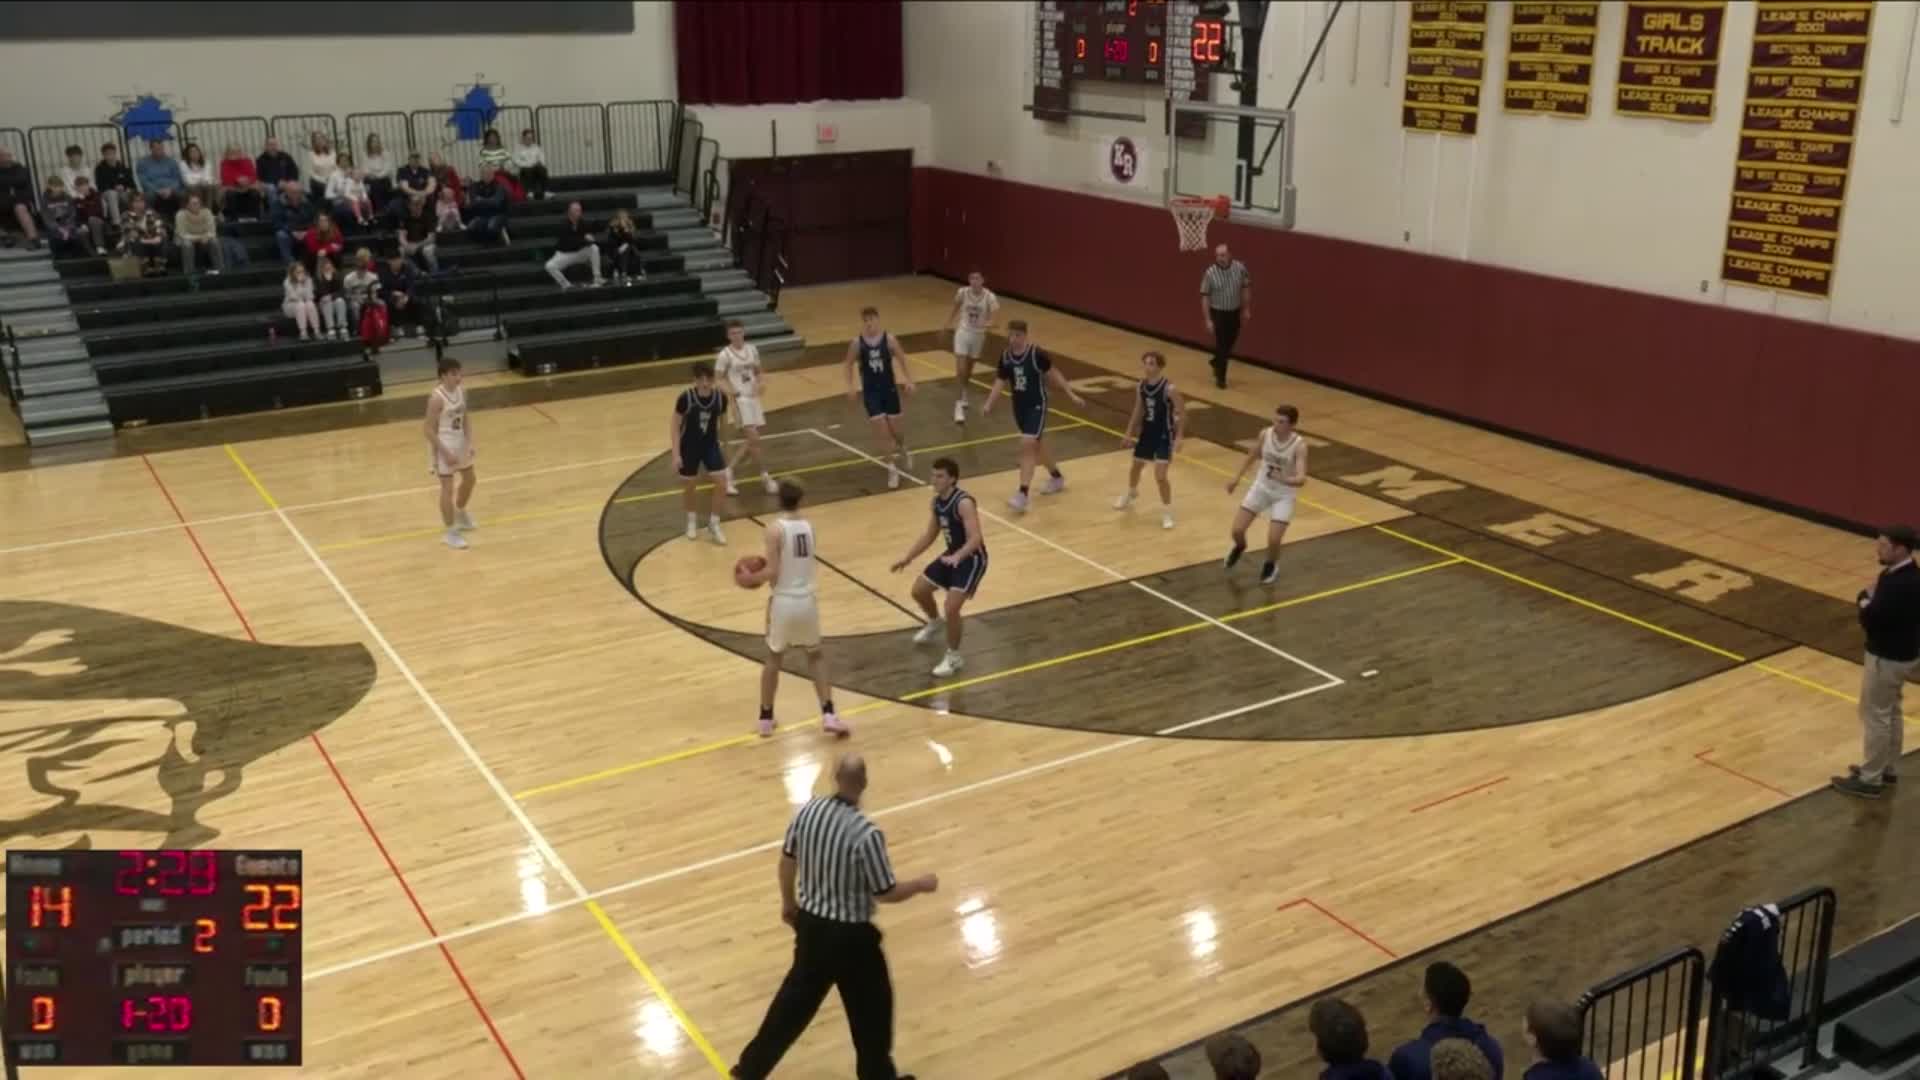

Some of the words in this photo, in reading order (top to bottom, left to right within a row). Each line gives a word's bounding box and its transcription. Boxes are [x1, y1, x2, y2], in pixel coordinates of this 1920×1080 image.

[1643, 12, 1704, 32] GIRLS
[1761, 10, 1808, 21] LEAGUE
[1813, 10, 1865, 22] CHAMPS
[1193, 22, 1222, 61] 22
[1636, 35, 1704, 55] TRACK
[1149, 42, 1158, 62] 0
[1621, 90, 1661, 101] LEAGUE
[1664, 93, 1709, 104] CHAMPS
[1749, 107, 1795, 118] LEAGUE
[1799, 109, 1849, 121] CHAMPS
[1736, 197, 1783, 212] LEAGUE
[1786, 203, 1834, 217] CHAMPS
[1731, 228, 1777, 242] LEAGUE
[1781, 235, 1830, 249] CHAMPS
[1728, 257, 1774, 273] LEAGUE
[1776, 264, 1825, 281] CHAMPS
